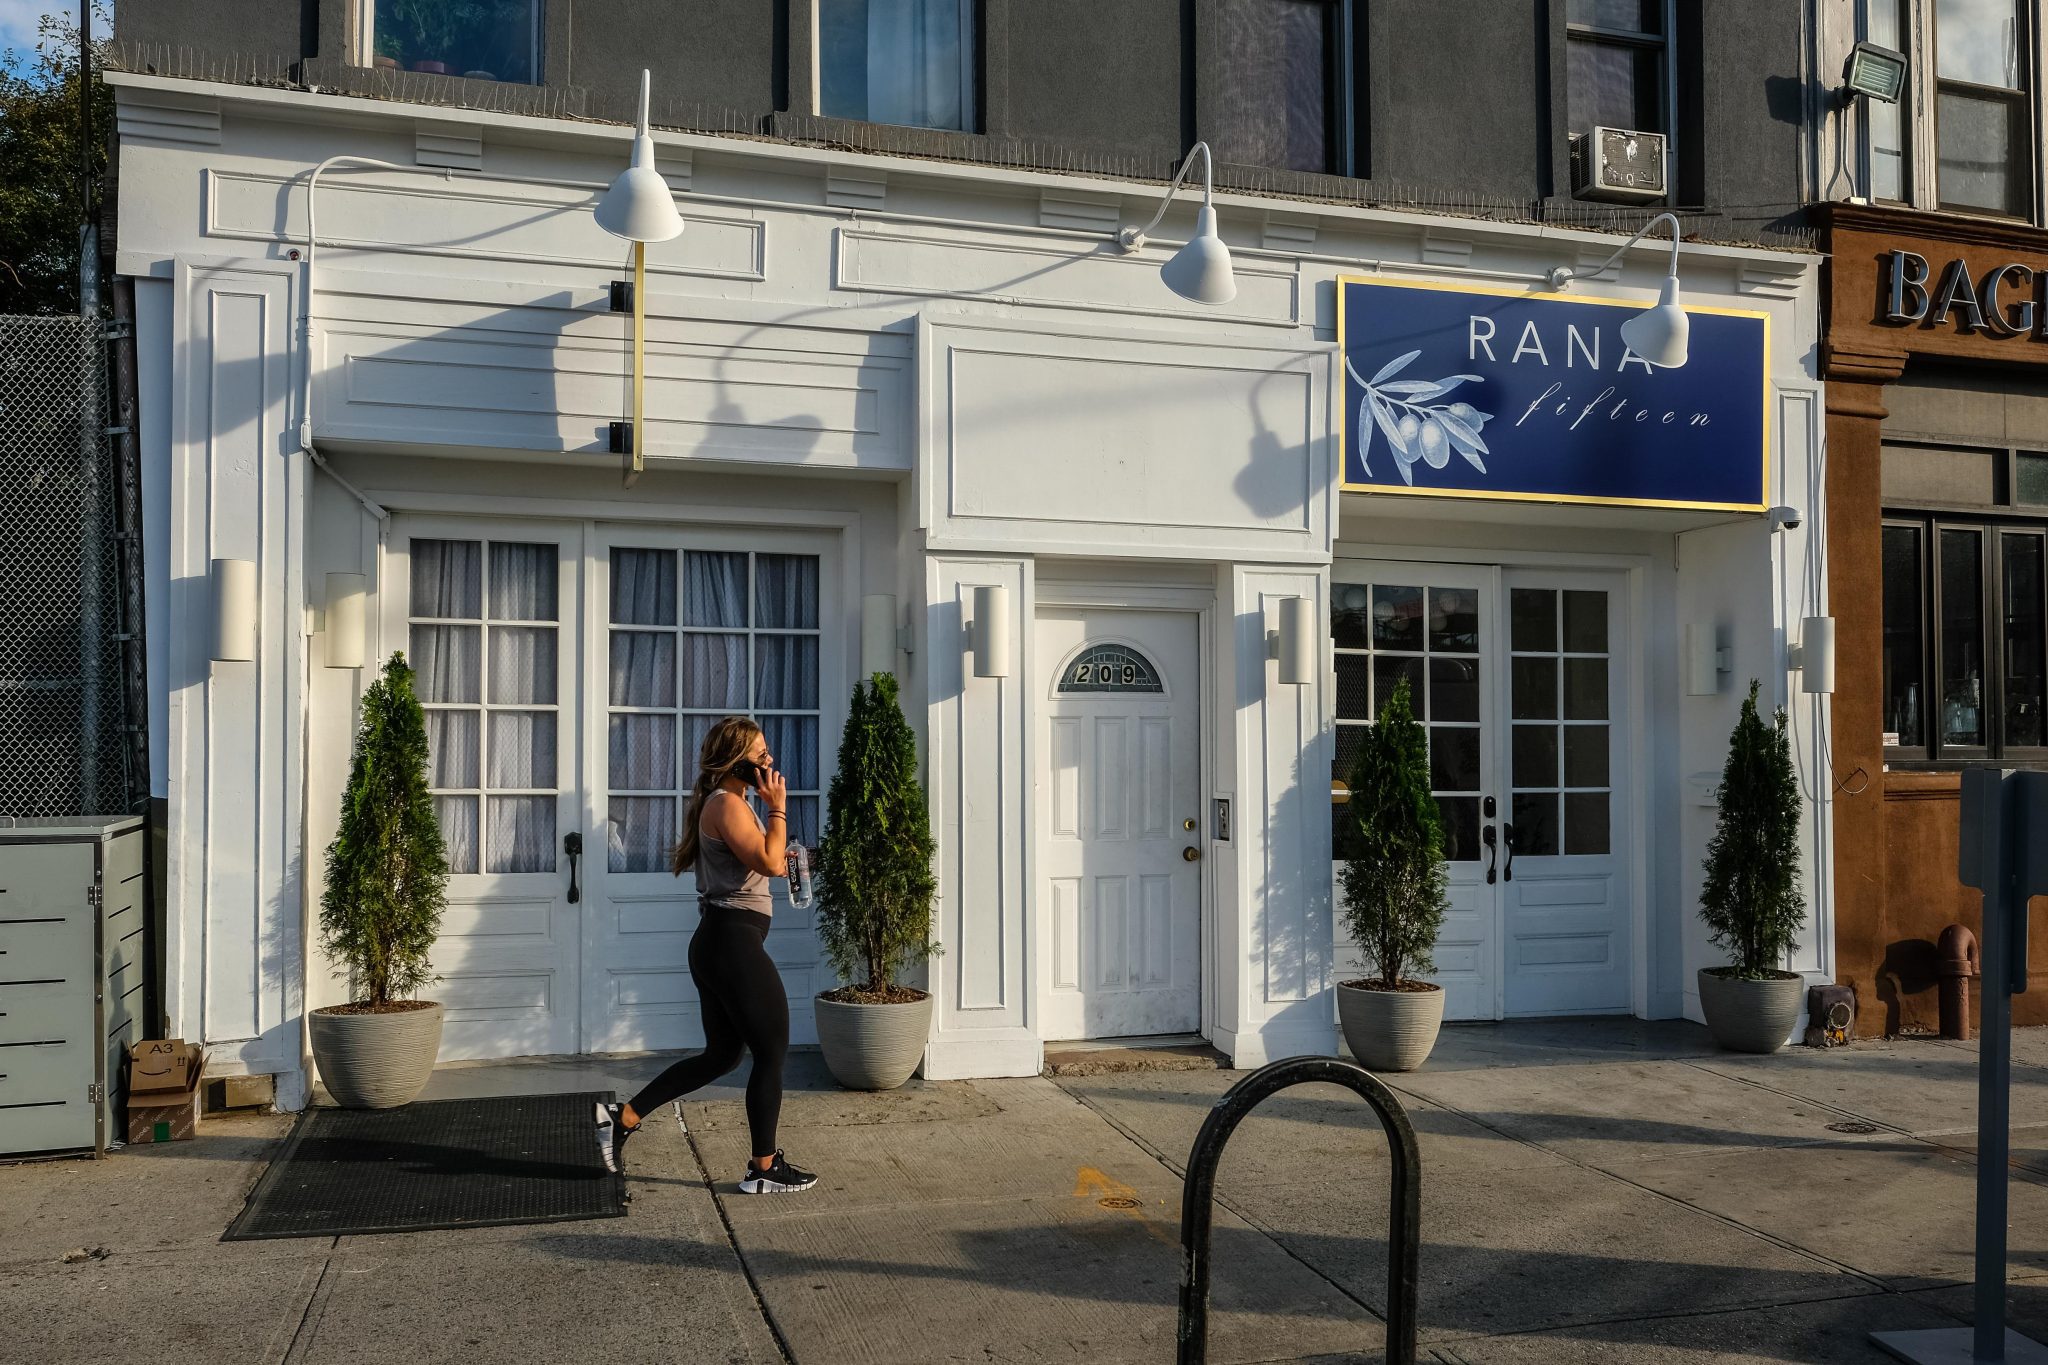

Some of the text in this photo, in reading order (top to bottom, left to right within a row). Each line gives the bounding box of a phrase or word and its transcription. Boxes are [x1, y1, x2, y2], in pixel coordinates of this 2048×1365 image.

[1516, 382, 1711, 430] fifteen
[1077, 665, 1134, 683] 209
[149, 1043, 174, 1054] A3
